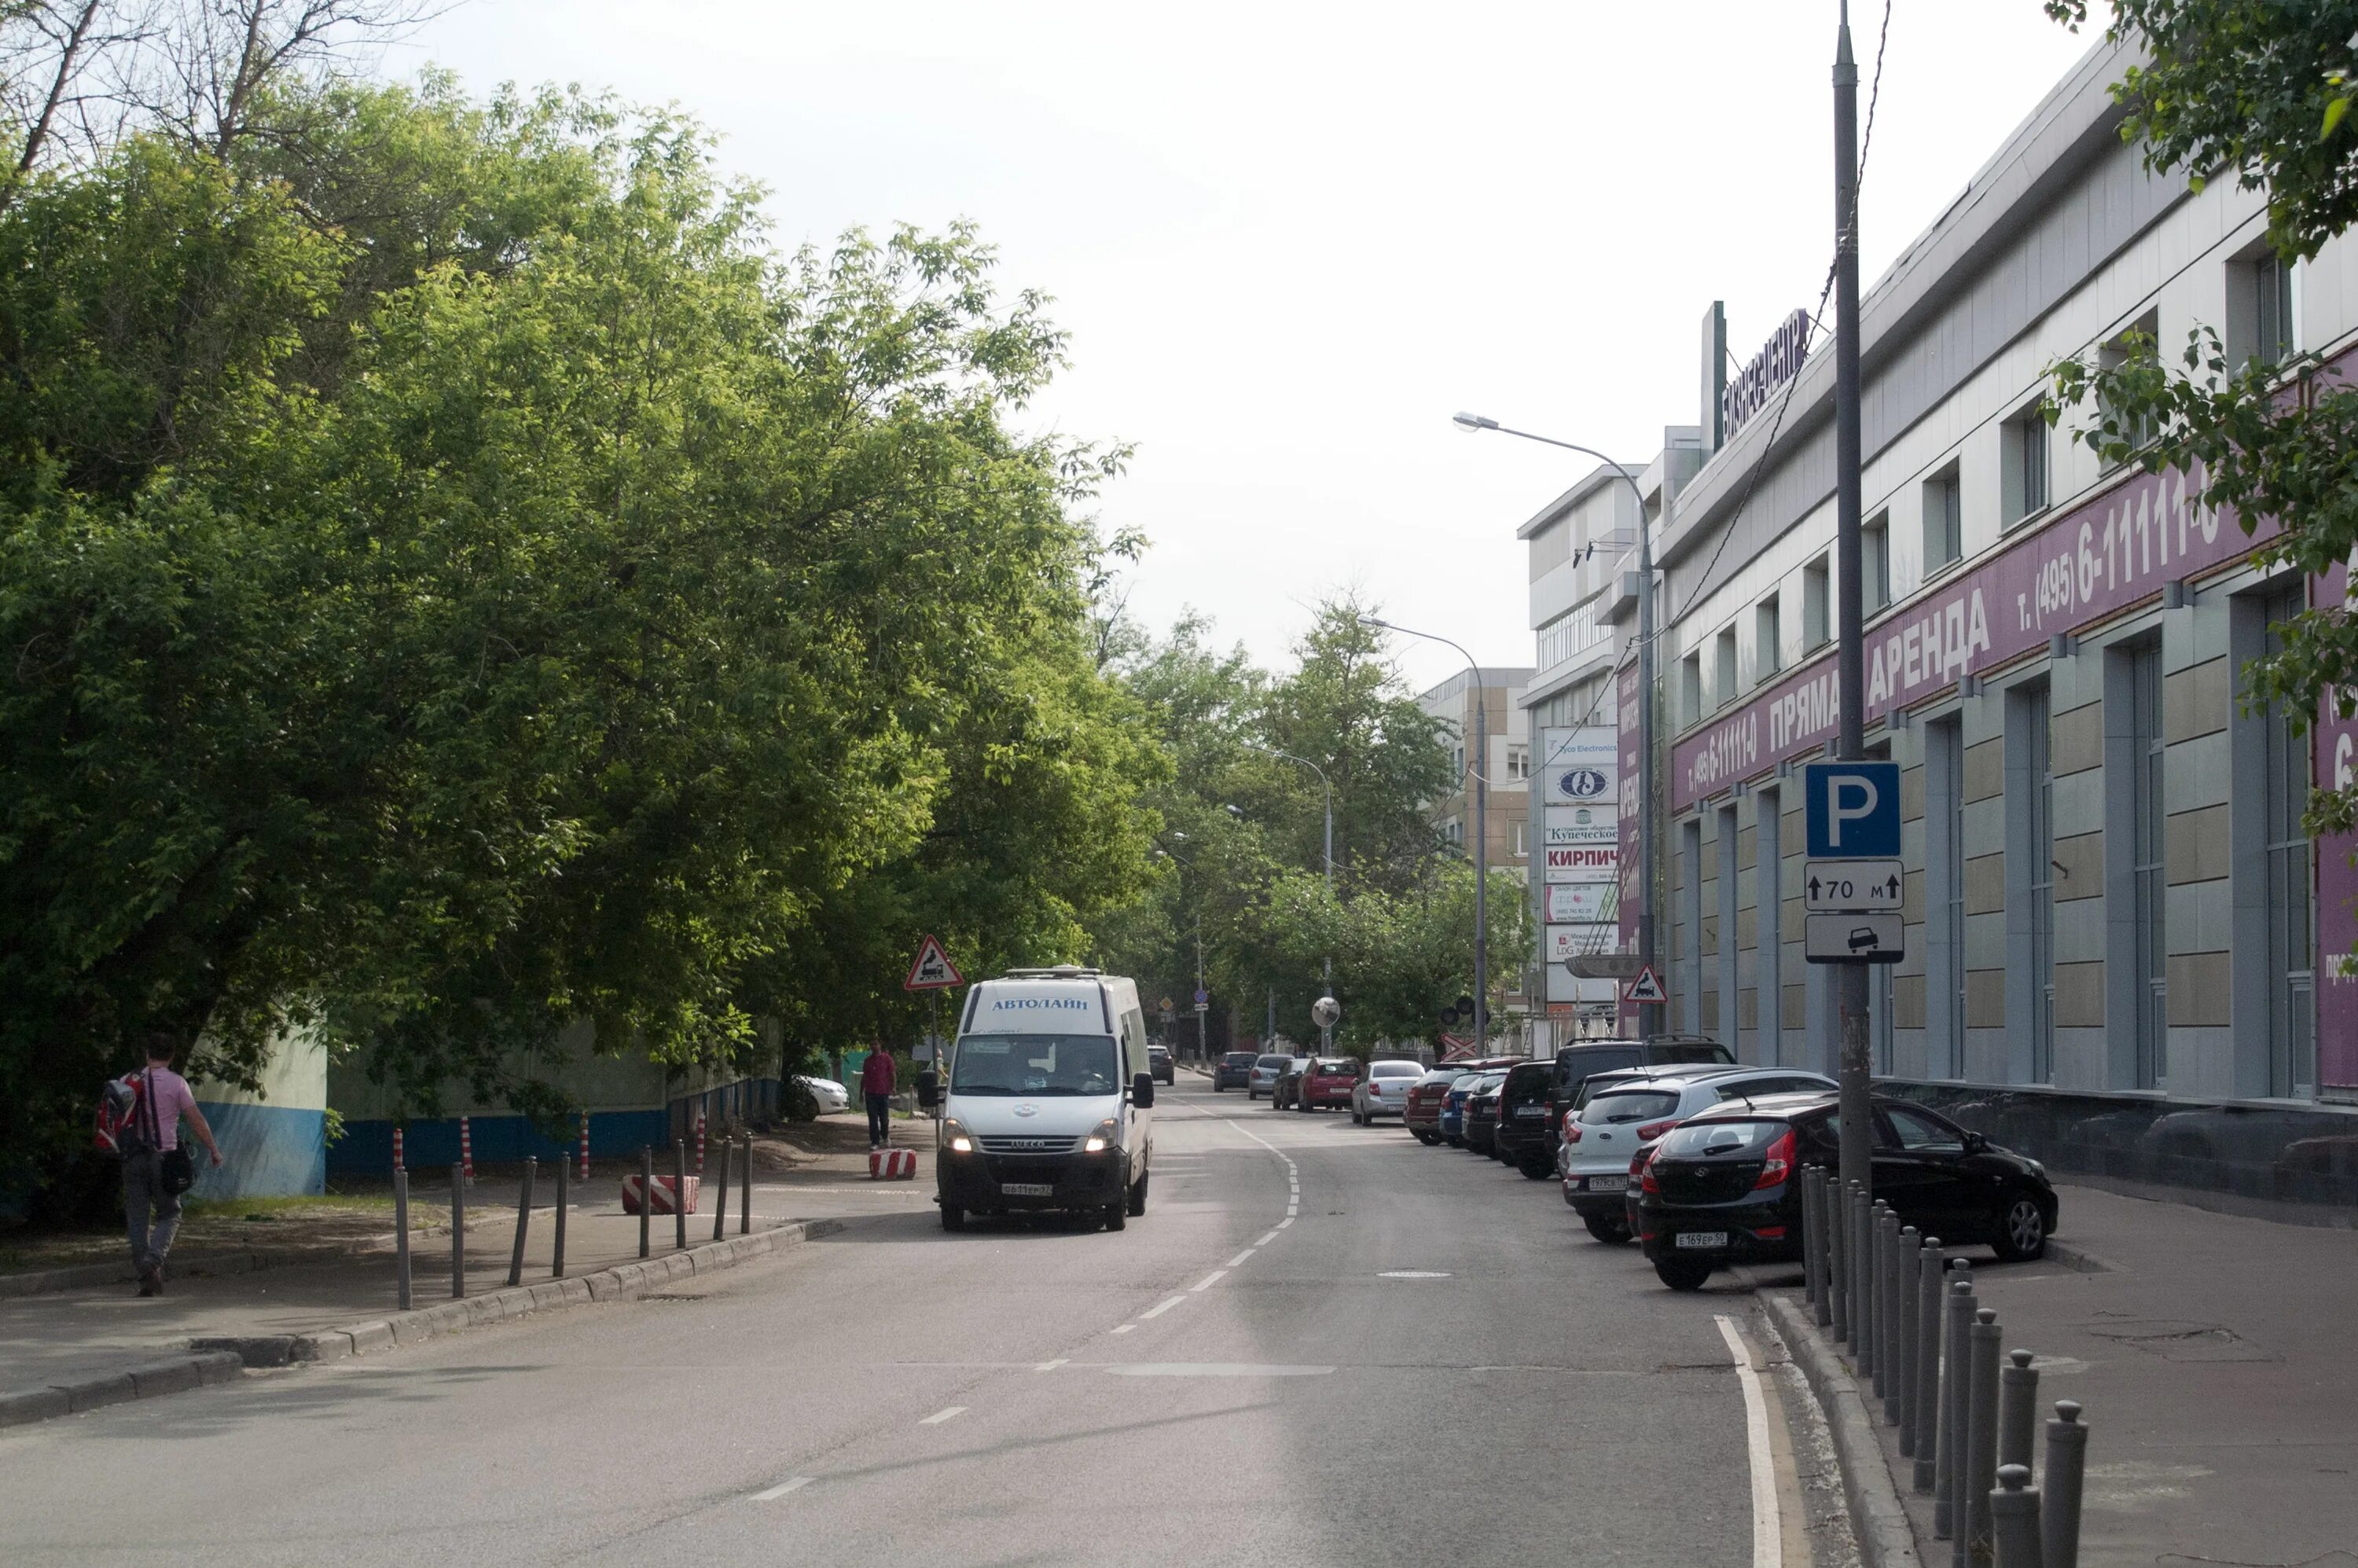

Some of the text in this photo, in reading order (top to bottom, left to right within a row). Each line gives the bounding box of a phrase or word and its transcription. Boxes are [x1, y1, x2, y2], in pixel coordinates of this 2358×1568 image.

[1868, 587, 1991, 707] АРЕНДА
[2035, 552, 2075, 630] (495)
[1577, 744, 1618, 753] Electronics
[1828, 776, 1878, 847] P
[1826, 881, 1853, 899] 70
[992, 997, 1089, 1012] АВТОЛАЙН
[1010, 1139, 1046, 1149] IVECO
